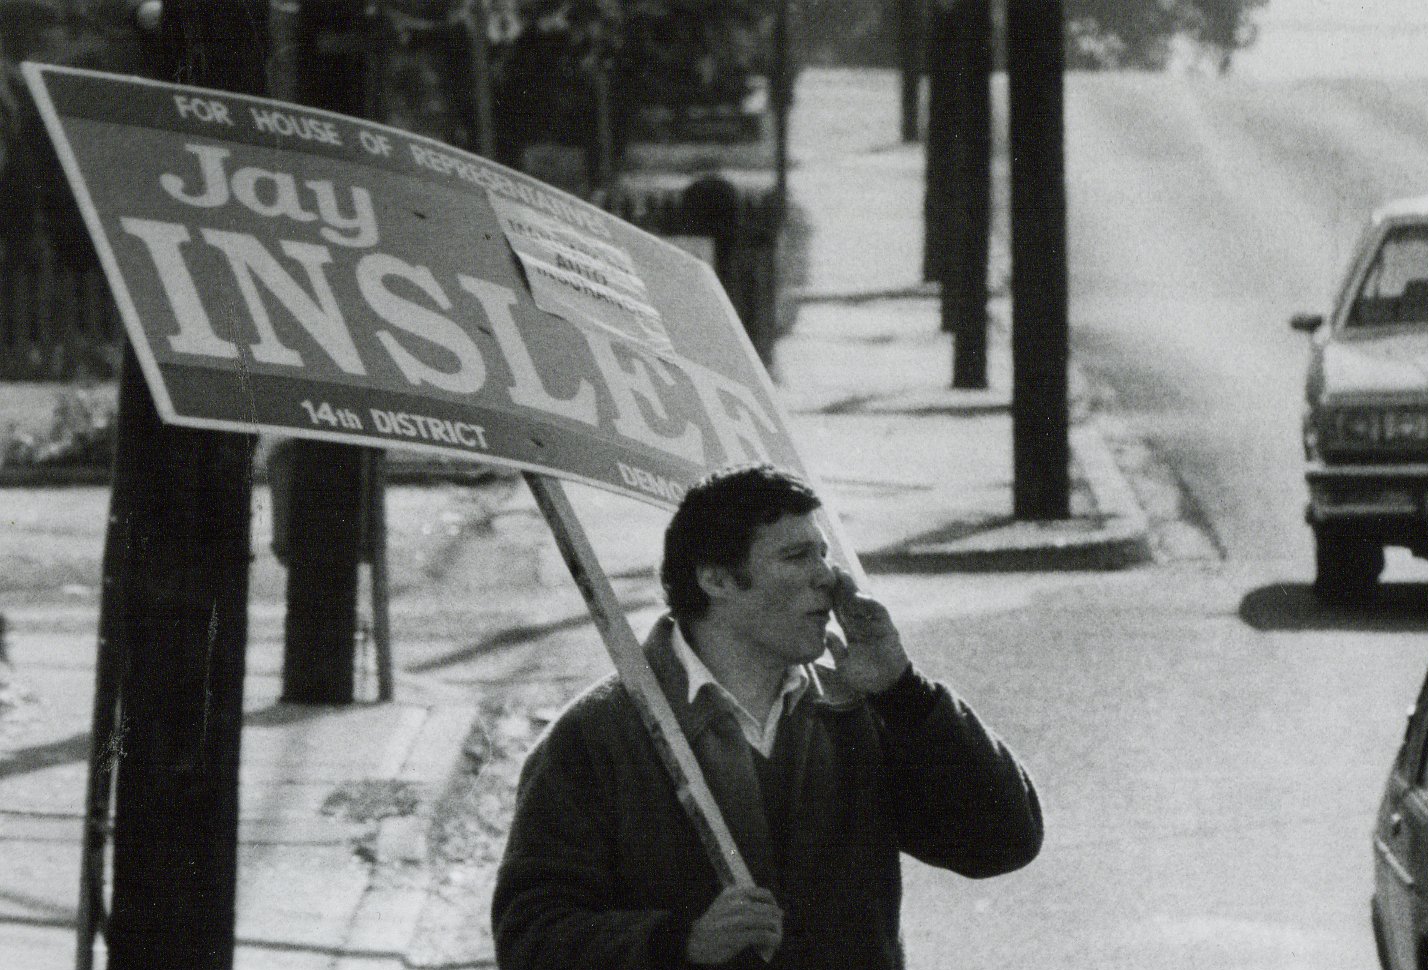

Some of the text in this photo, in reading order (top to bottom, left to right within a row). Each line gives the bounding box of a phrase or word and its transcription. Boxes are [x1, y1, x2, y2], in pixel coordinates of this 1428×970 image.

[173, 95, 234, 126] FOR
[251, 107, 342, 146] HOUSE
[359, 130, 392, 158] OF
[160, 142, 379, 248] Jay
[301, 400, 488, 449] 14th DISTRICT
[617, 462, 687, 502] DEMO
